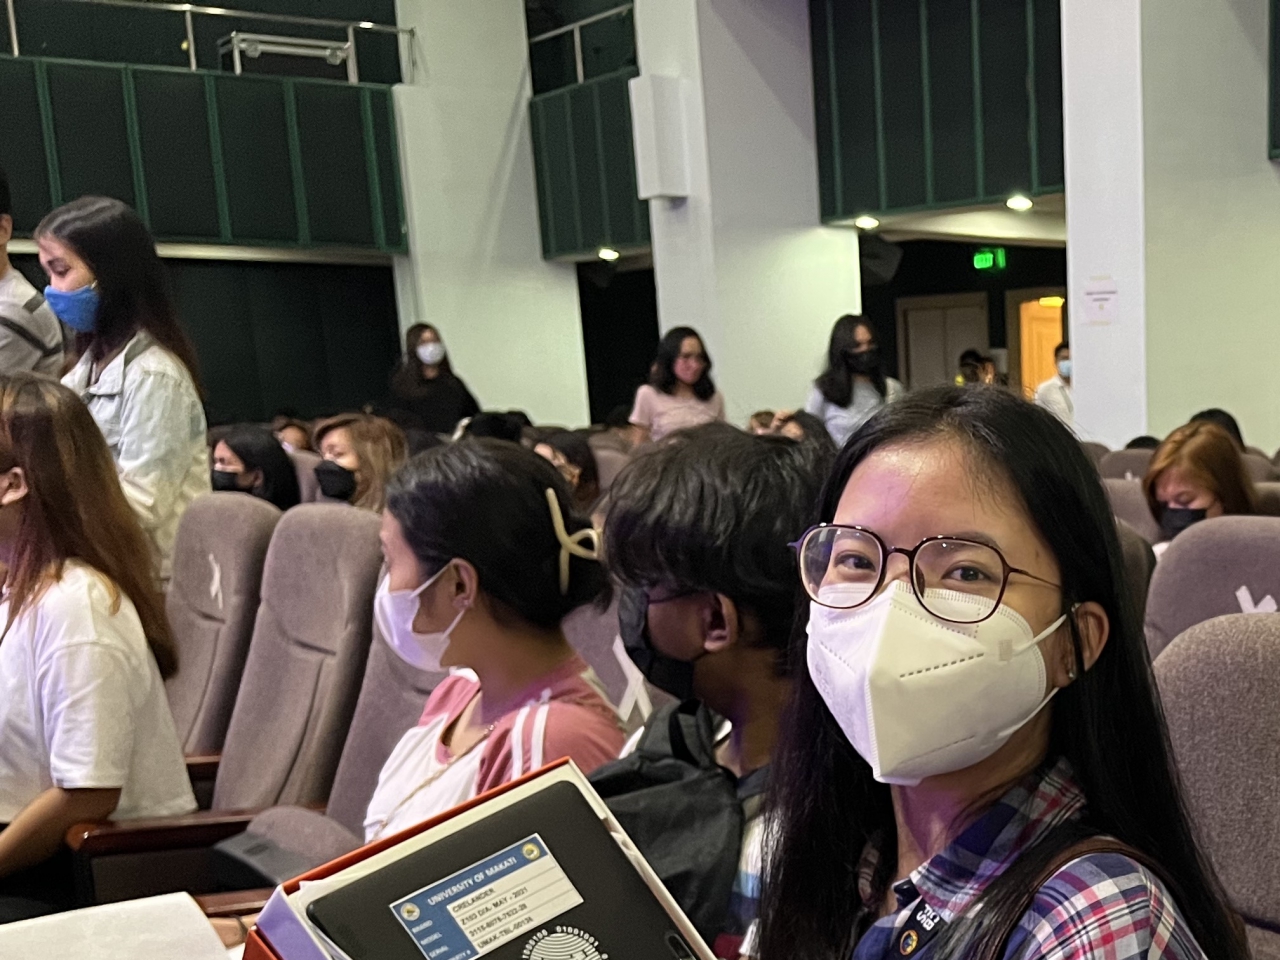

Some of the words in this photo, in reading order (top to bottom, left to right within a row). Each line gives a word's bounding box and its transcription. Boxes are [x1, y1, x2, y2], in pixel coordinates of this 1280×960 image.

[427, 878, 473, 905] UNIVERSITY
[473, 871, 485, 882] OF
[484, 856, 517, 876] MAKATI
[451, 887, 495, 913] CRELANDER
